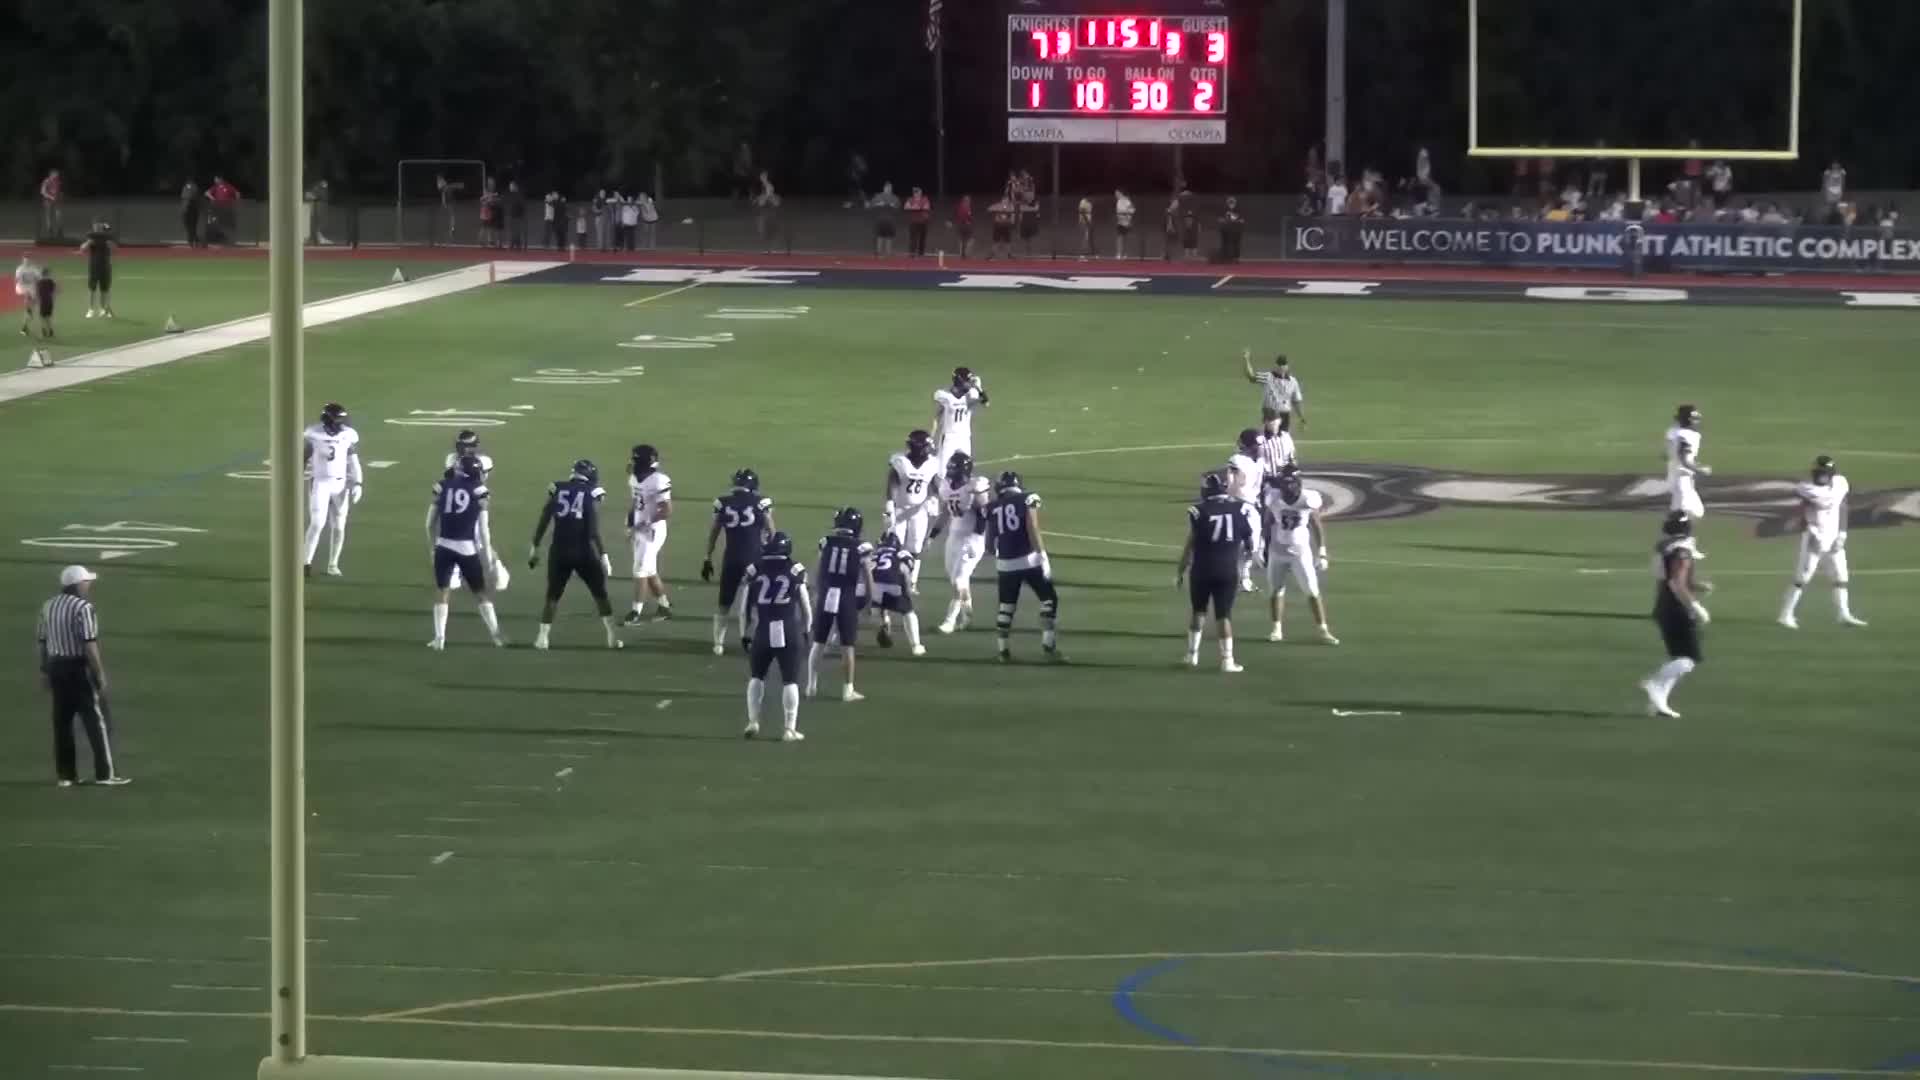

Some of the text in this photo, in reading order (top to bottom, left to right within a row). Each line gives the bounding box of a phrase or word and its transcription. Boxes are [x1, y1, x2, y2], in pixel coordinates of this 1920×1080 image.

[1011, 18, 1070, 32] KNIGHTS
[1183, 18, 1225, 33] GUEST
[1032, 31, 1048, 59] 7
[1057, 31, 1071, 54] 3
[1166, 32, 1180, 55] 3
[1208, 33, 1225, 63] 3
[1011, 66, 1054, 80] DOWN
[1066, 67, 1107, 80] TO GO
[1125, 67, 1175, 80] BALL ON
[1190, 67, 1217, 81] QTR
[1032, 82, 1040, 108] 1
[1076, 81, 1104, 111] 10
[1132, 81, 1168, 111] 30
[1194, 82, 1213, 111] 2
[1011, 127, 1065, 139] OLYMPIA
[1168, 127, 1223, 140] OLYMPIA
[1296, 227, 1324, 250] IC
[1360, 229, 1920, 261] WELCOME TO PLUNKTT ATHLETIC COMPLEX
[444, 487, 470, 513] 19
[558, 489, 585, 518] 54
[1209, 514, 1233, 541] 71
[828, 546, 850, 575] 11
[756, 575, 791, 604] 22
